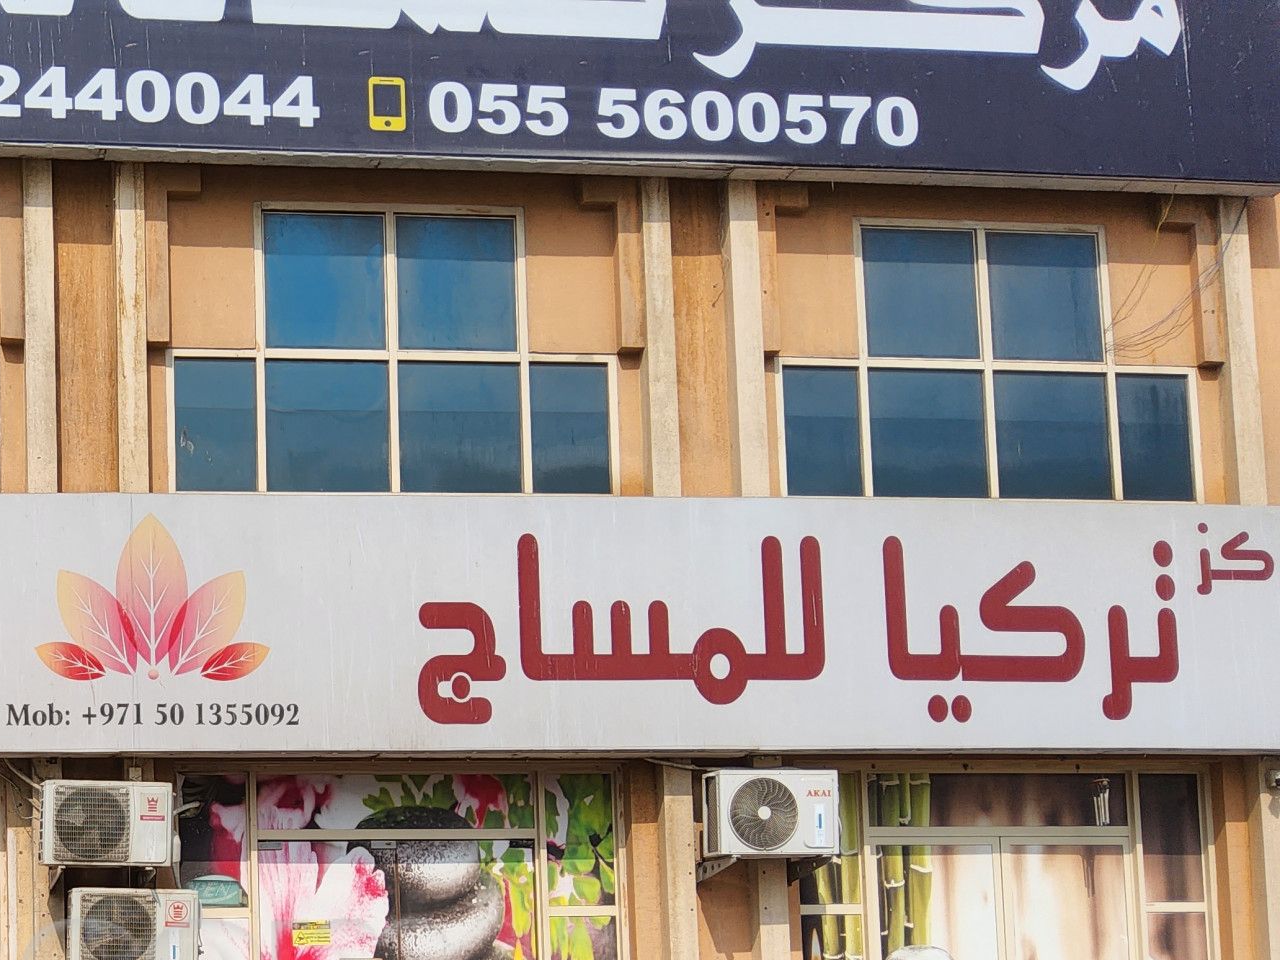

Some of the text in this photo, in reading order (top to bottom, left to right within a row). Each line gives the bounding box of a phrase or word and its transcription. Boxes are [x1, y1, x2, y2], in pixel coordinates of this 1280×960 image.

[428, 81, 919, 147] 055 5600570
[418, 533, 825, 725] للمساج
[883, 535, 1180, 721] تركيا
[6, 703, 300, 726] Mob: +971 50 1355092
[806, 789, 831, 797] AKAI
